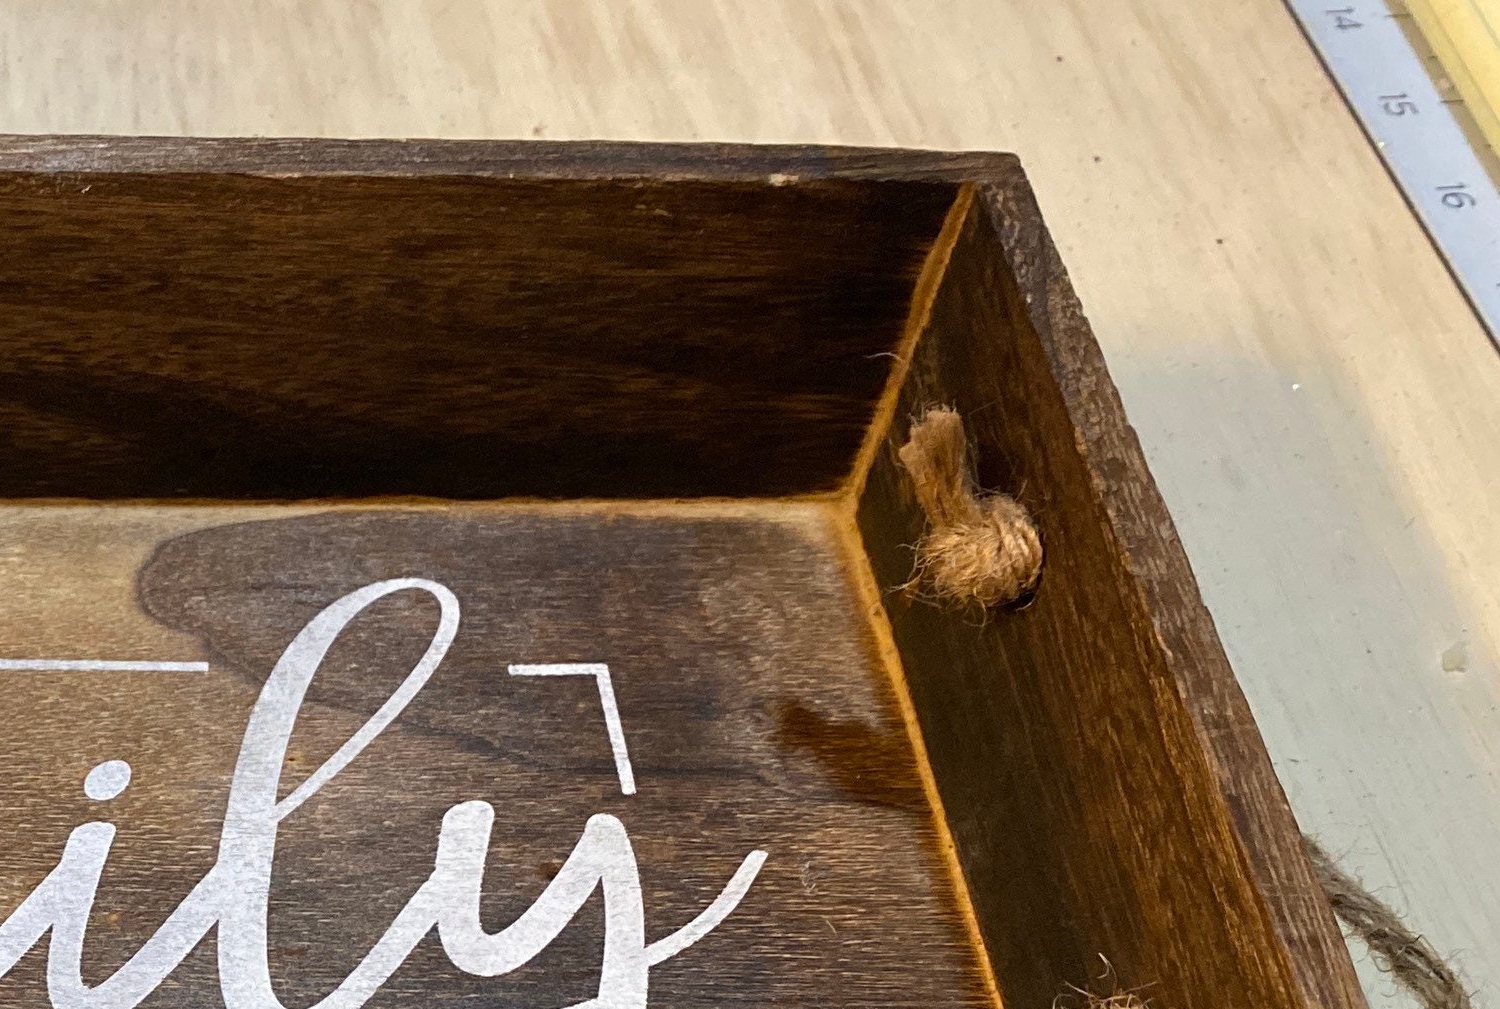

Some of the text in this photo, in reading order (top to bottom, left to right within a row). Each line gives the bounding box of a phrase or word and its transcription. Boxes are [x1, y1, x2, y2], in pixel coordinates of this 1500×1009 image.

[1325, 7, 1364, 31] 14
[1378, 92, 1420, 118] 15
[1435, 182, 1476, 210] 16
